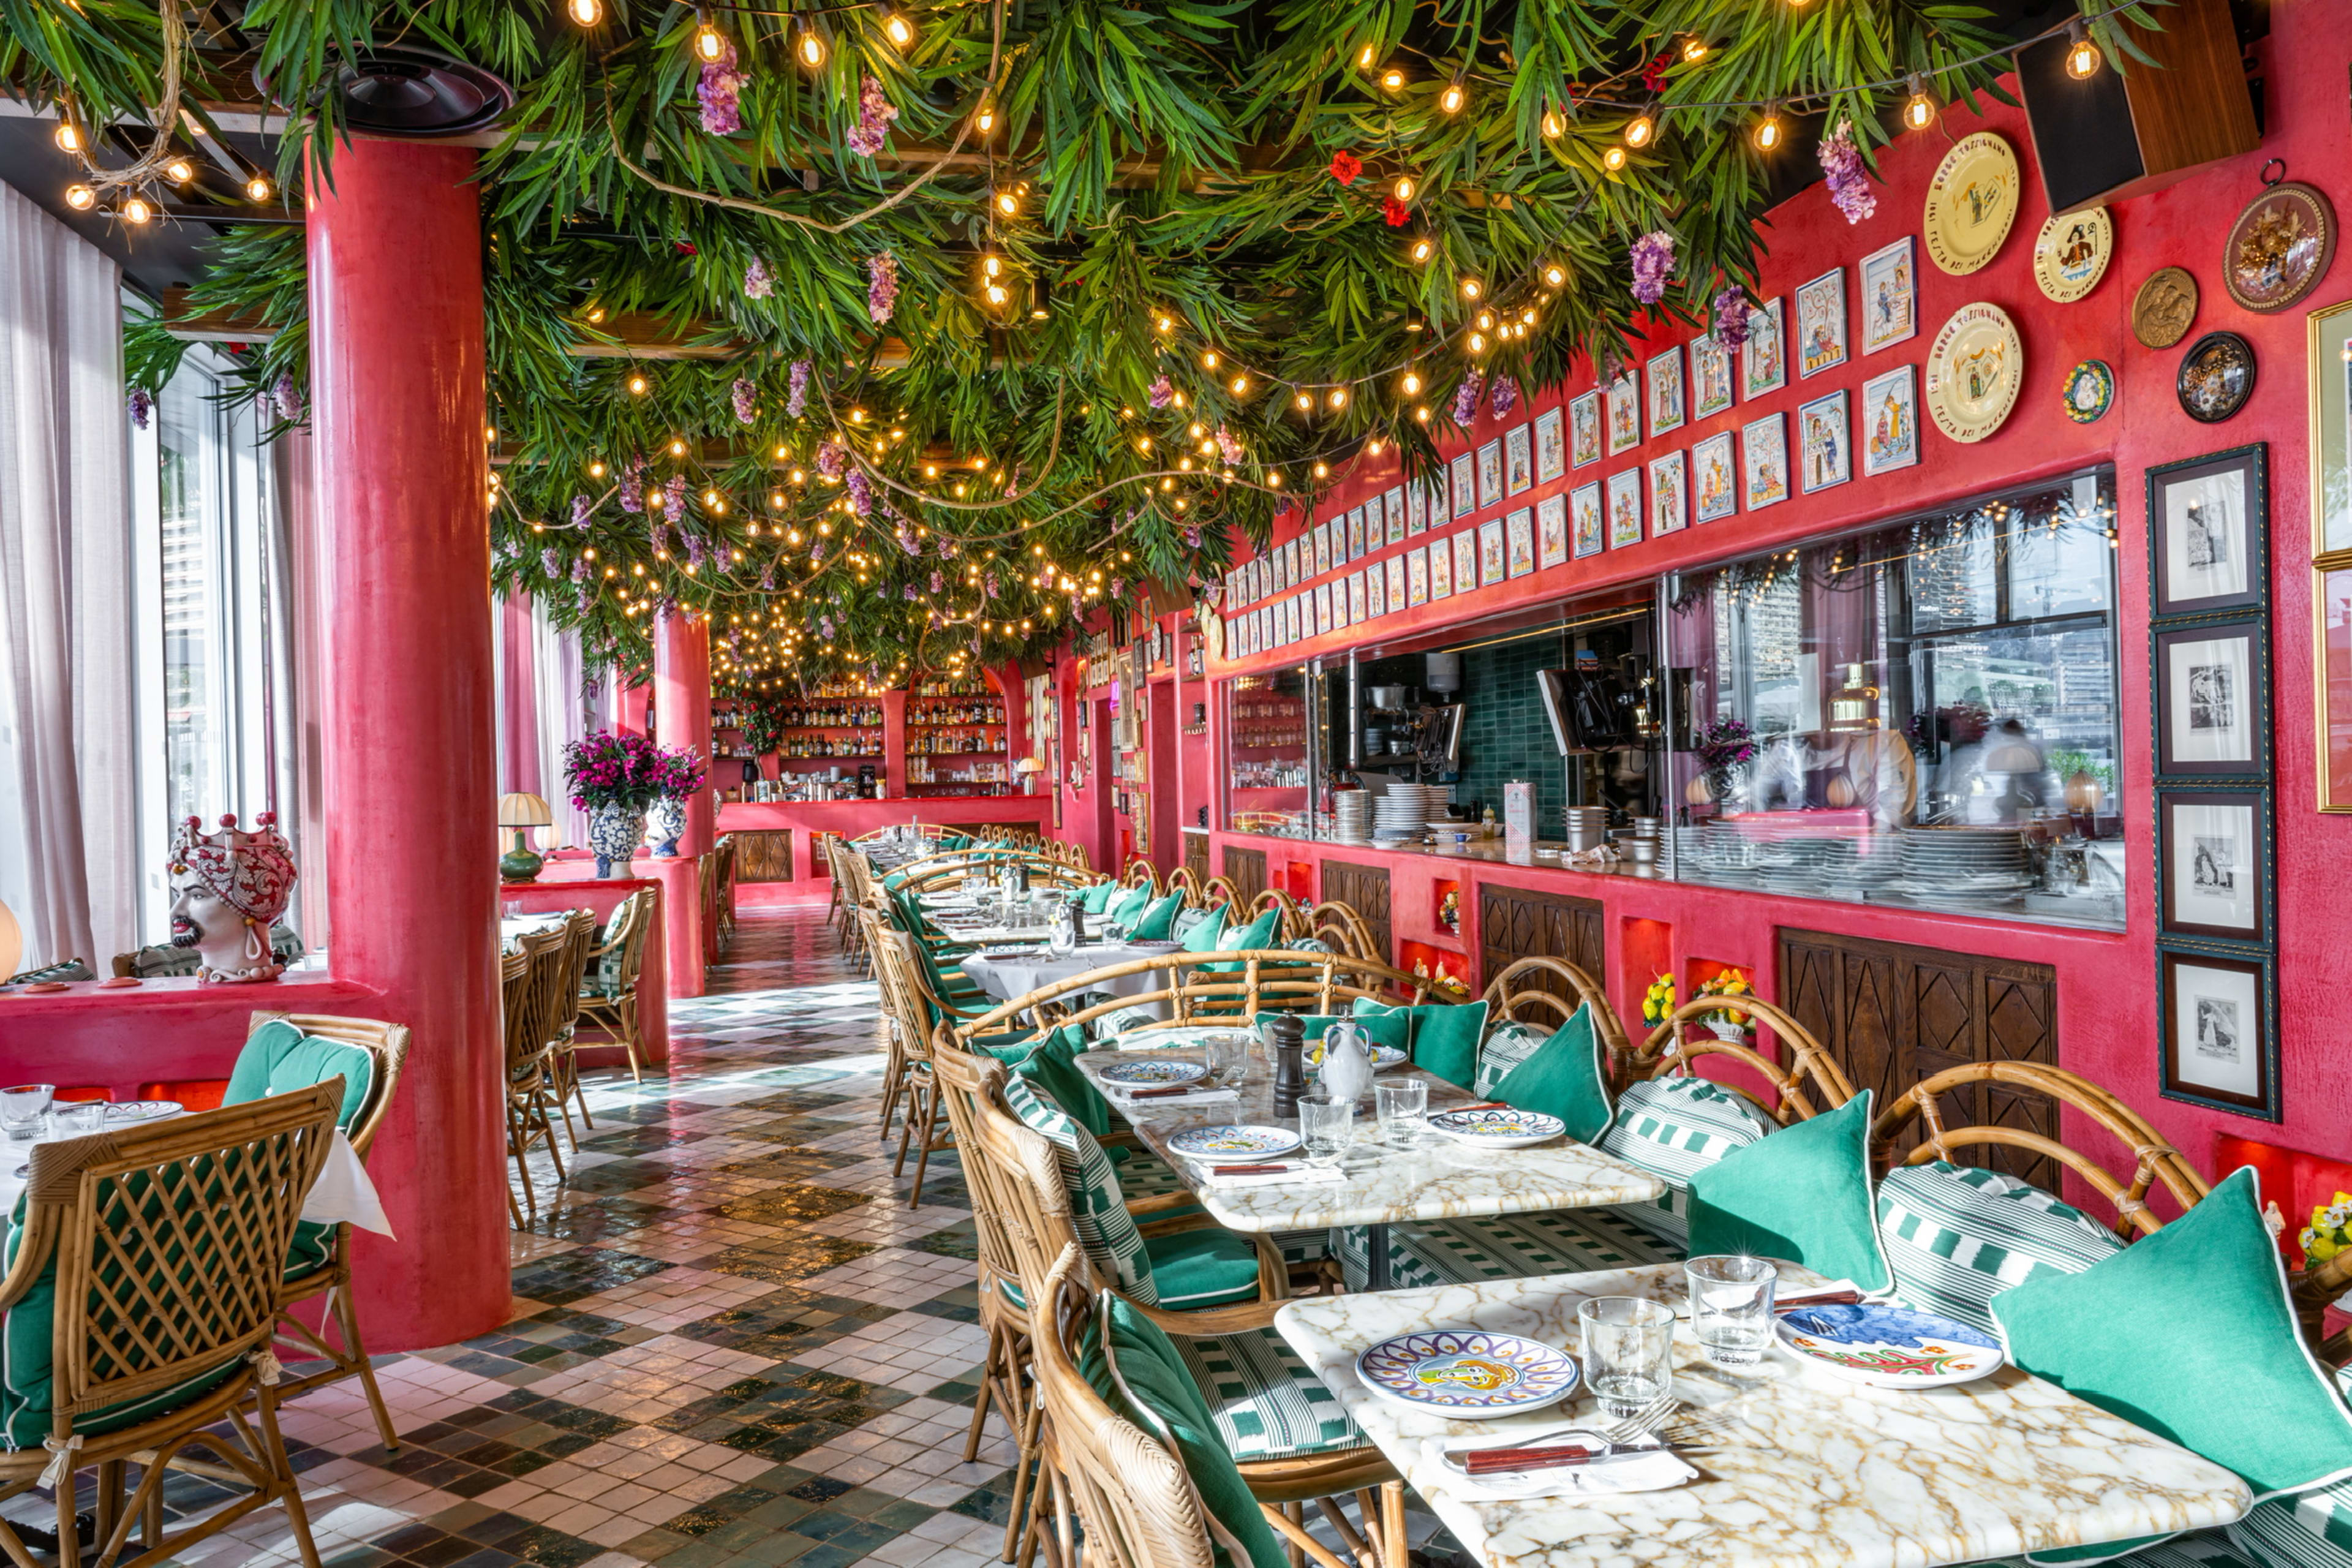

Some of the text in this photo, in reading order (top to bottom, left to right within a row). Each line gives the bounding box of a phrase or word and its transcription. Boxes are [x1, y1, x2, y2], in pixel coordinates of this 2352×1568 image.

[1958, 139, 2005, 156] TOSSIGNANO
[1930, 230, 1947, 263] FESTA
[1950, 261, 1963, 270] DEI
[2040, 271, 2055, 294] FESTA
[1957, 309, 2005, 328] TOSSIGNANO
[1935, 405, 1957, 434] FESTA
